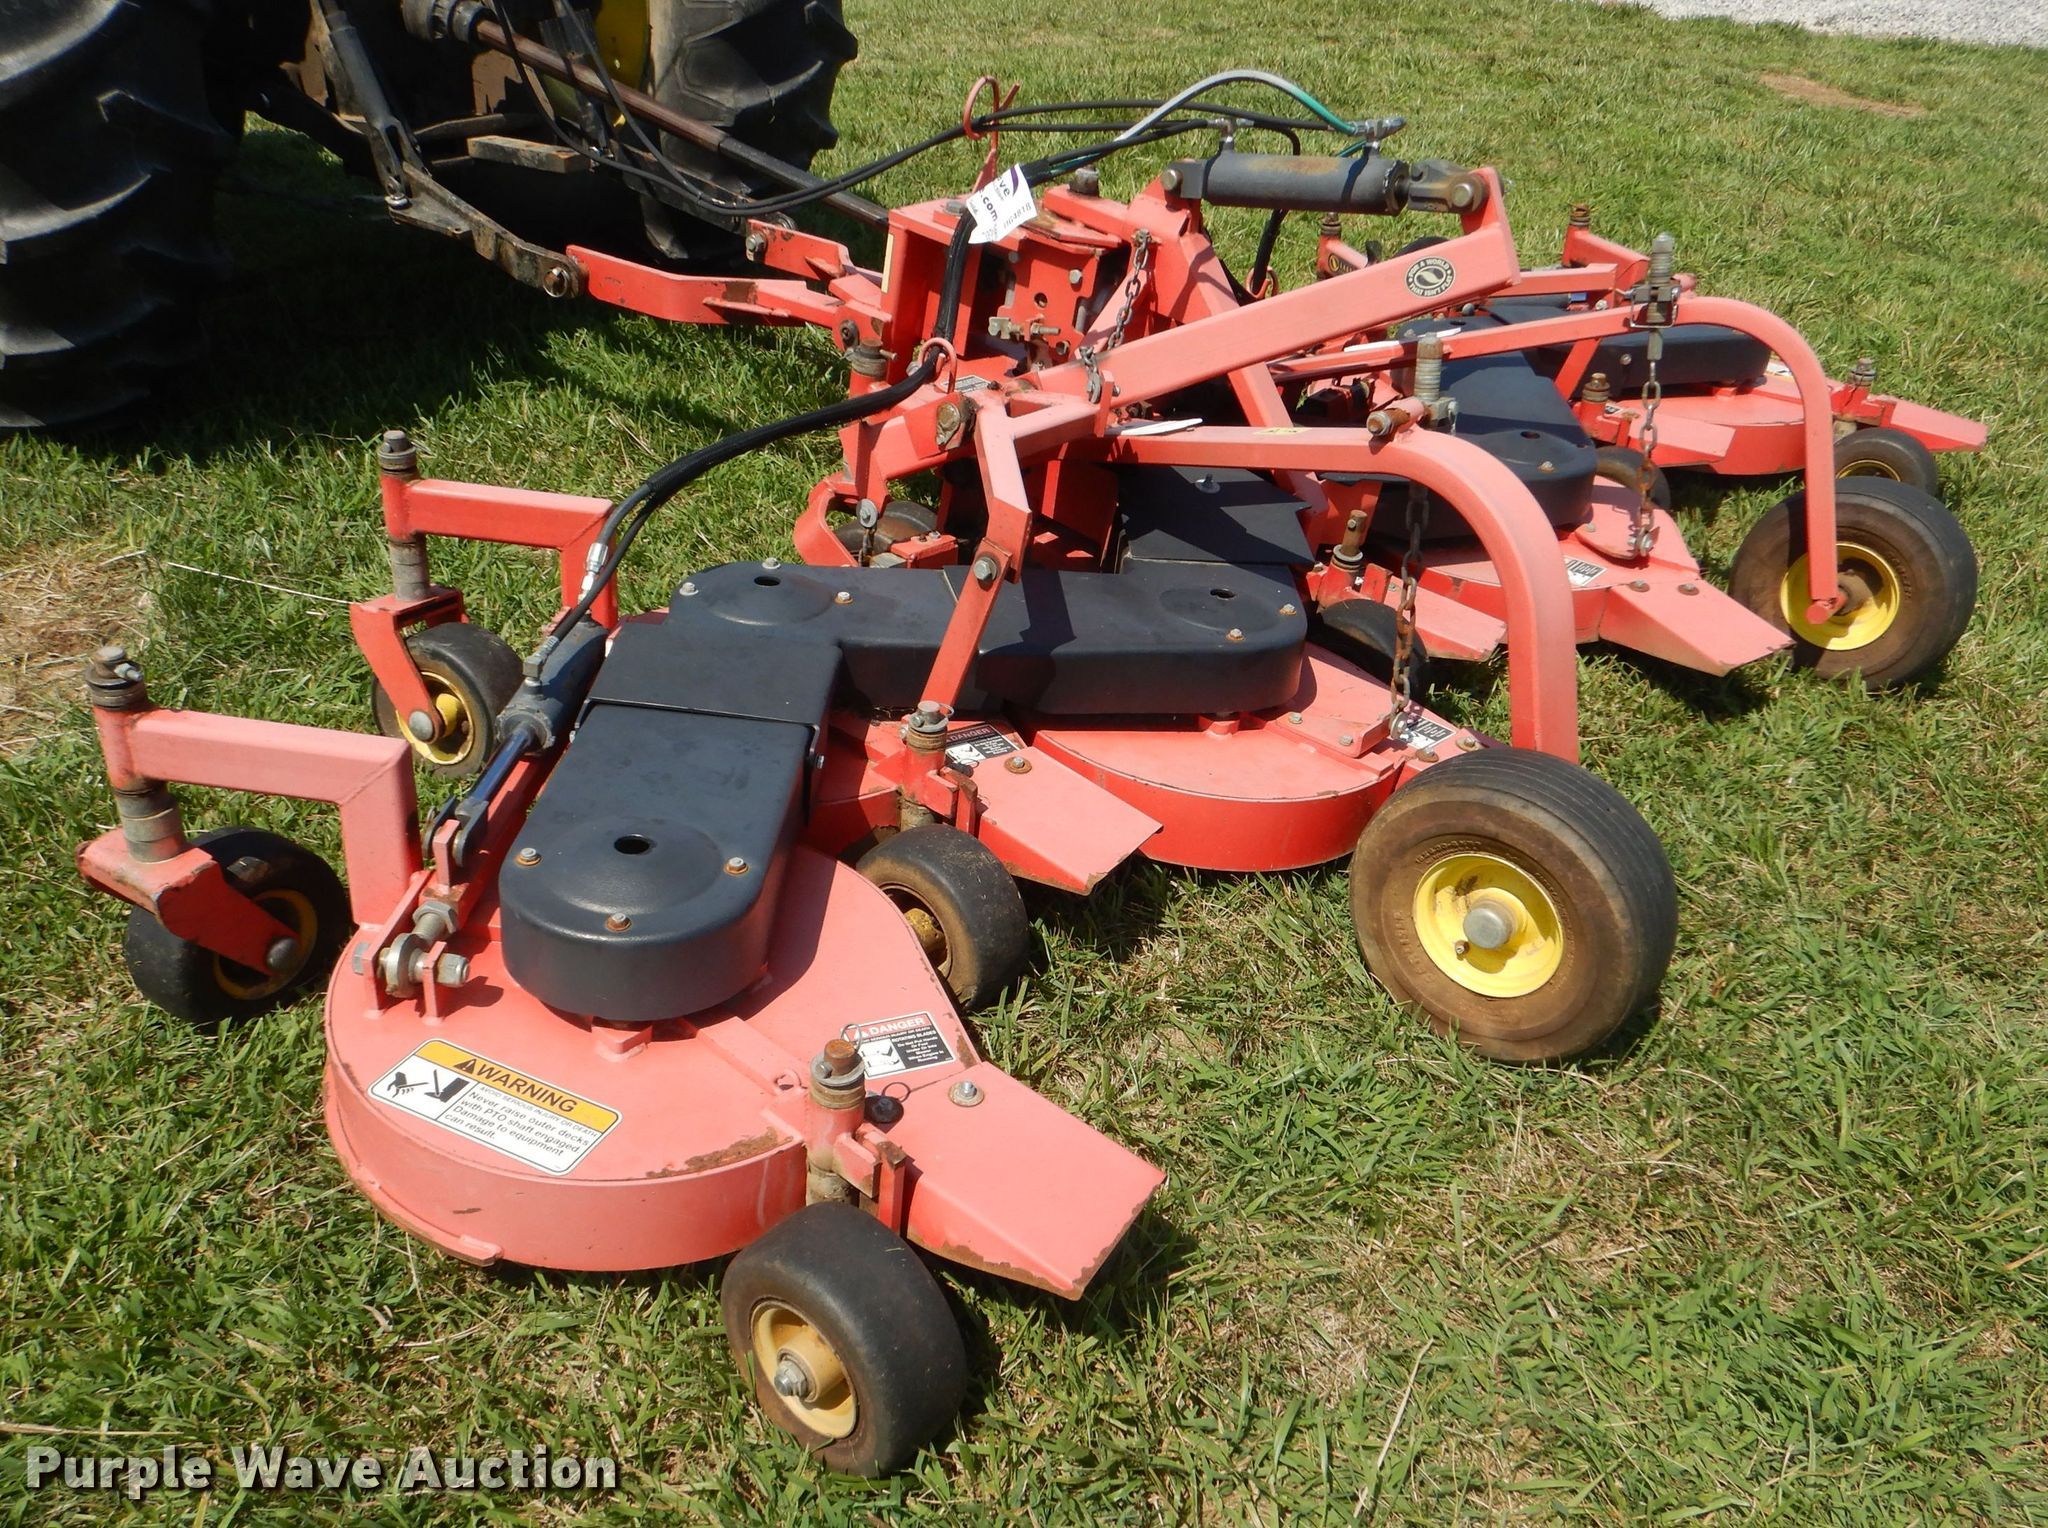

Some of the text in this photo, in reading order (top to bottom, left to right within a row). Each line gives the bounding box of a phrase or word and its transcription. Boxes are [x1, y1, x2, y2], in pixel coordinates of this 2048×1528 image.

[1426, 258, 1450, 270] WORLD
[950, 727, 991, 741] DANGER
[868, 1017, 925, 1035] DANGER
[476, 1064, 577, 1112] WARNING
[480, 1086, 597, 1137] AVOID SERIOUS INJURY OR DEATH
[445, 1114, 496, 1139] can result.
[453, 1105, 564, 1156] Damage to equipment
[461, 1100, 580, 1153] with PTO shaft engaged.
[469, 1091, 589, 1146] Never raise outer decks
